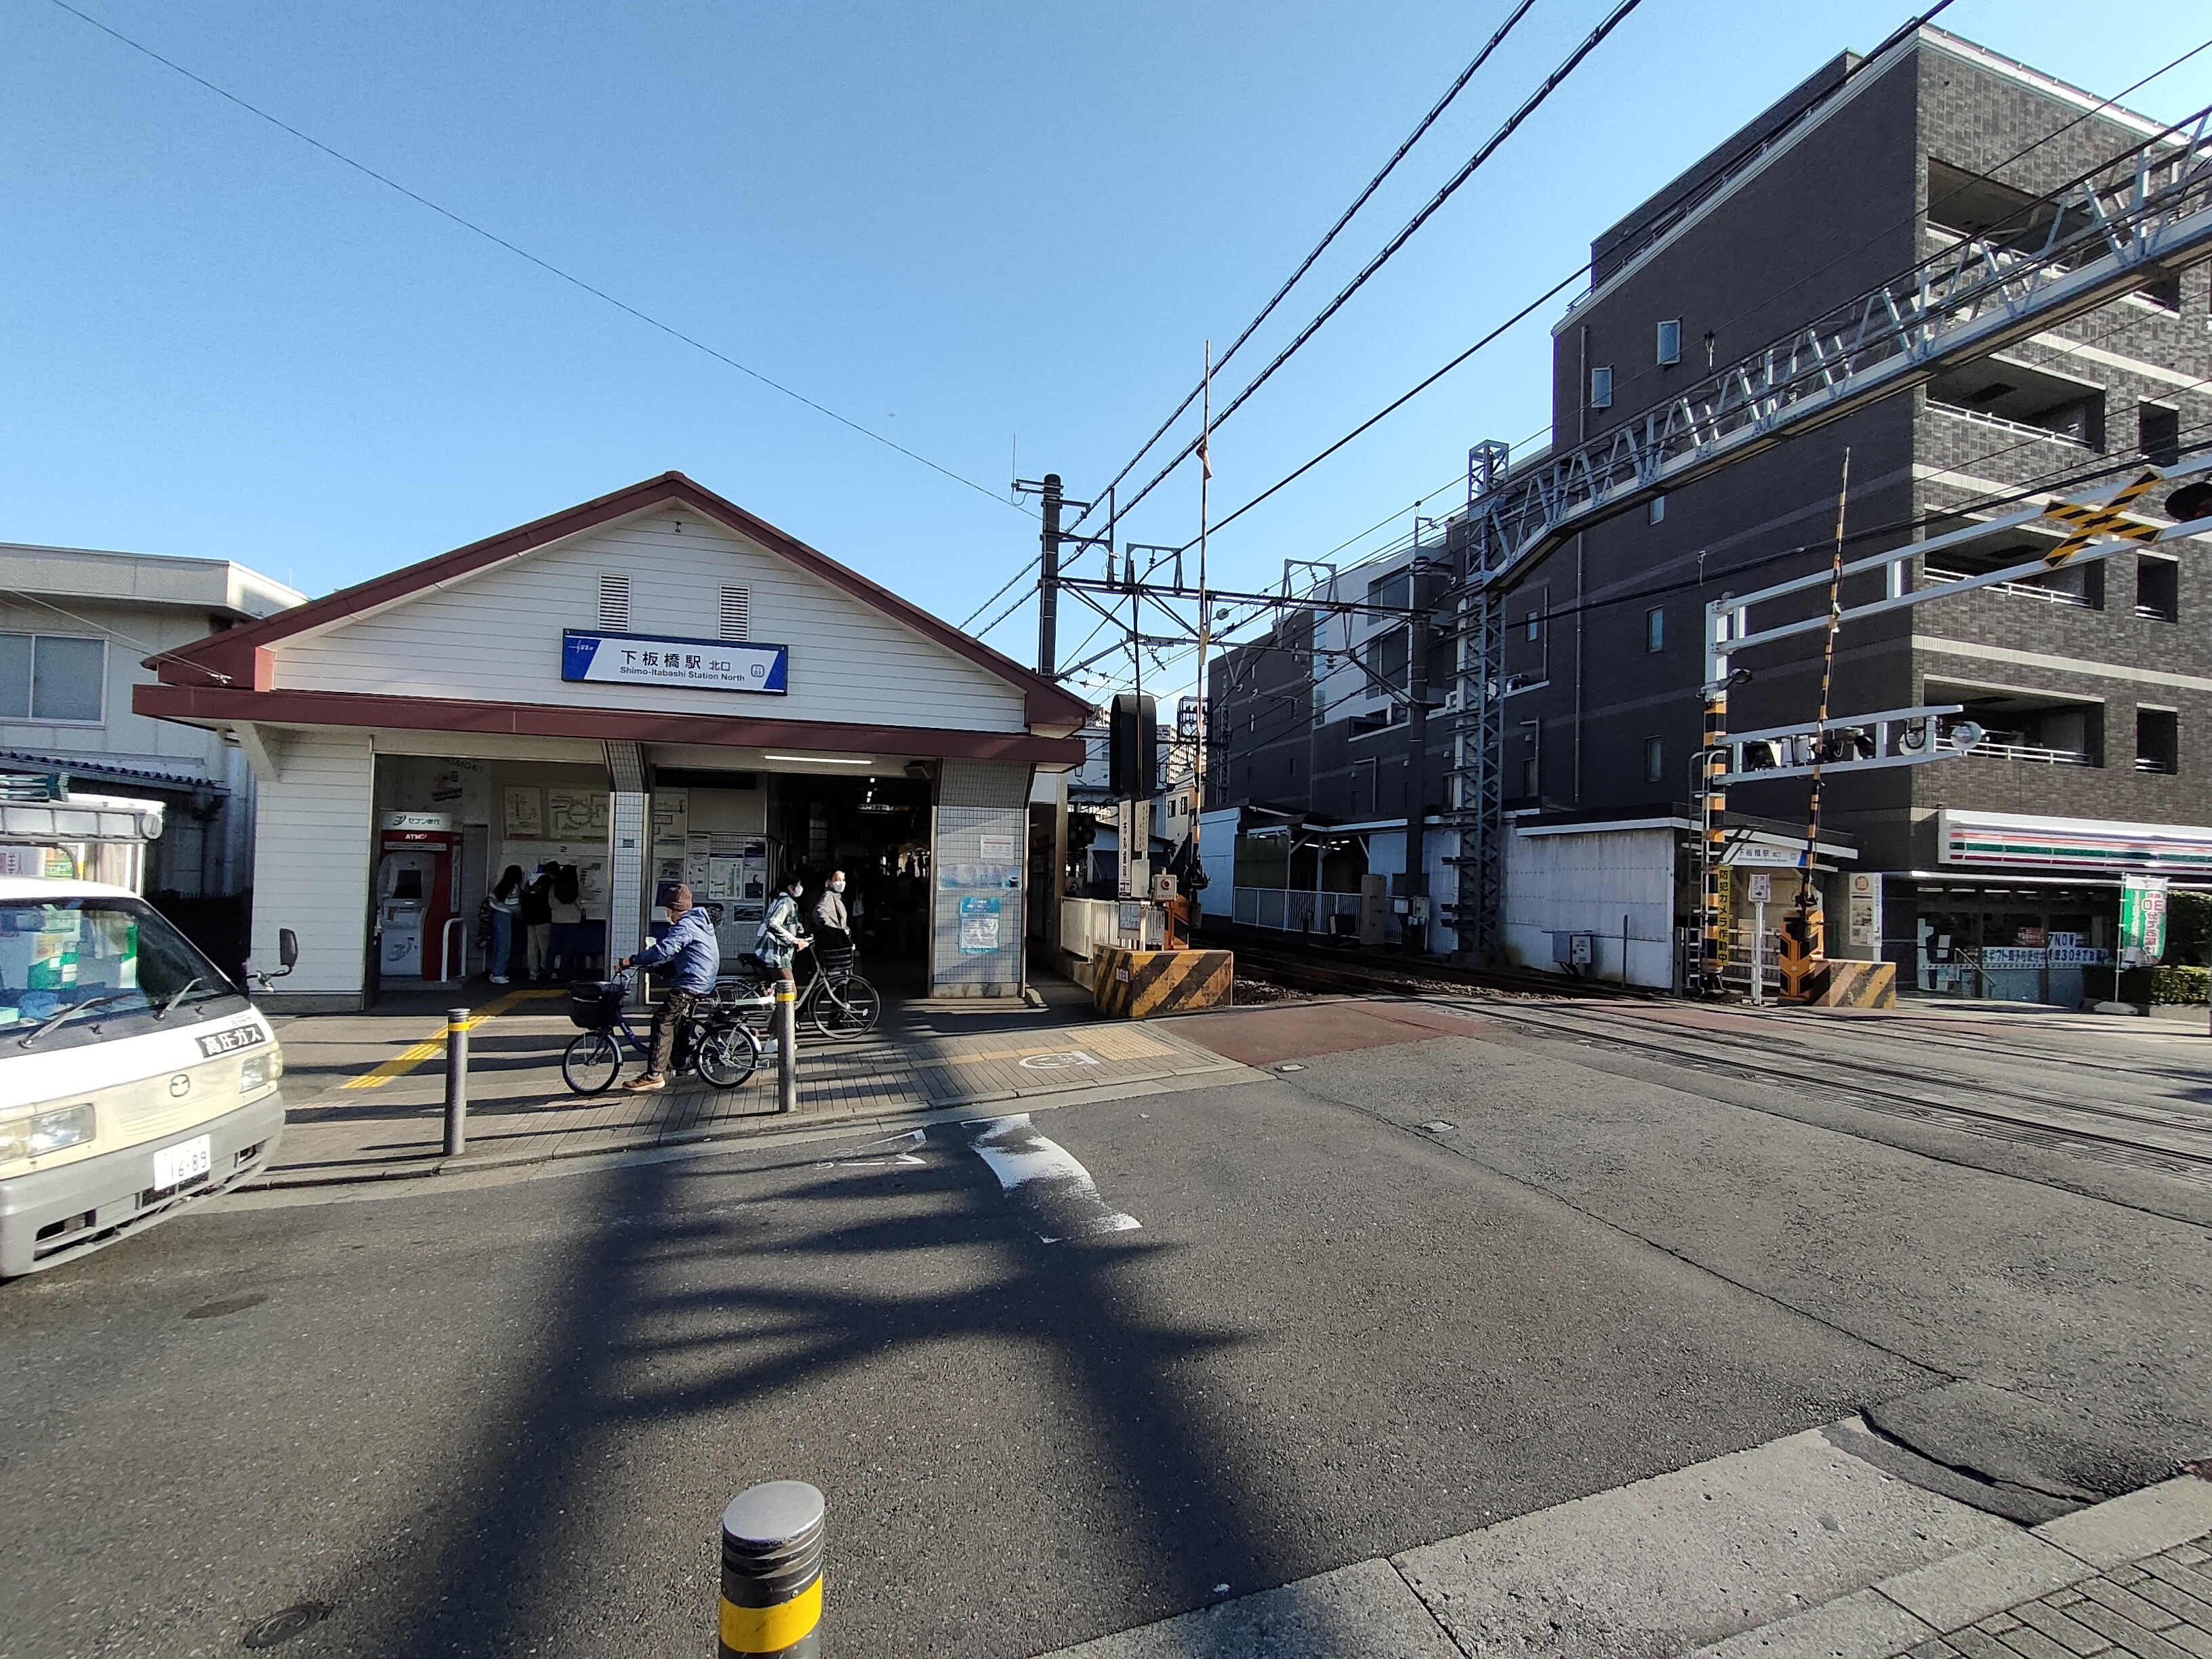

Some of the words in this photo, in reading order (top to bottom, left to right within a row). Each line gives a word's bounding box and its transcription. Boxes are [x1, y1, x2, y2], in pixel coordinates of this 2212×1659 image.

[620, 649, 701, 670] 下板橋駅
[709, 660, 731, 672] 北口
[619, 666, 687, 678] Shimo-Itabashi
[688, 670, 719, 680] Station
[720, 673, 745, 682] North
[408, 817, 440, 825] セブン銀行
[1718, 869, 1729, 963] 防犯カメラ作動中
[202, 1027, 264, 1055] 高圧ガス
